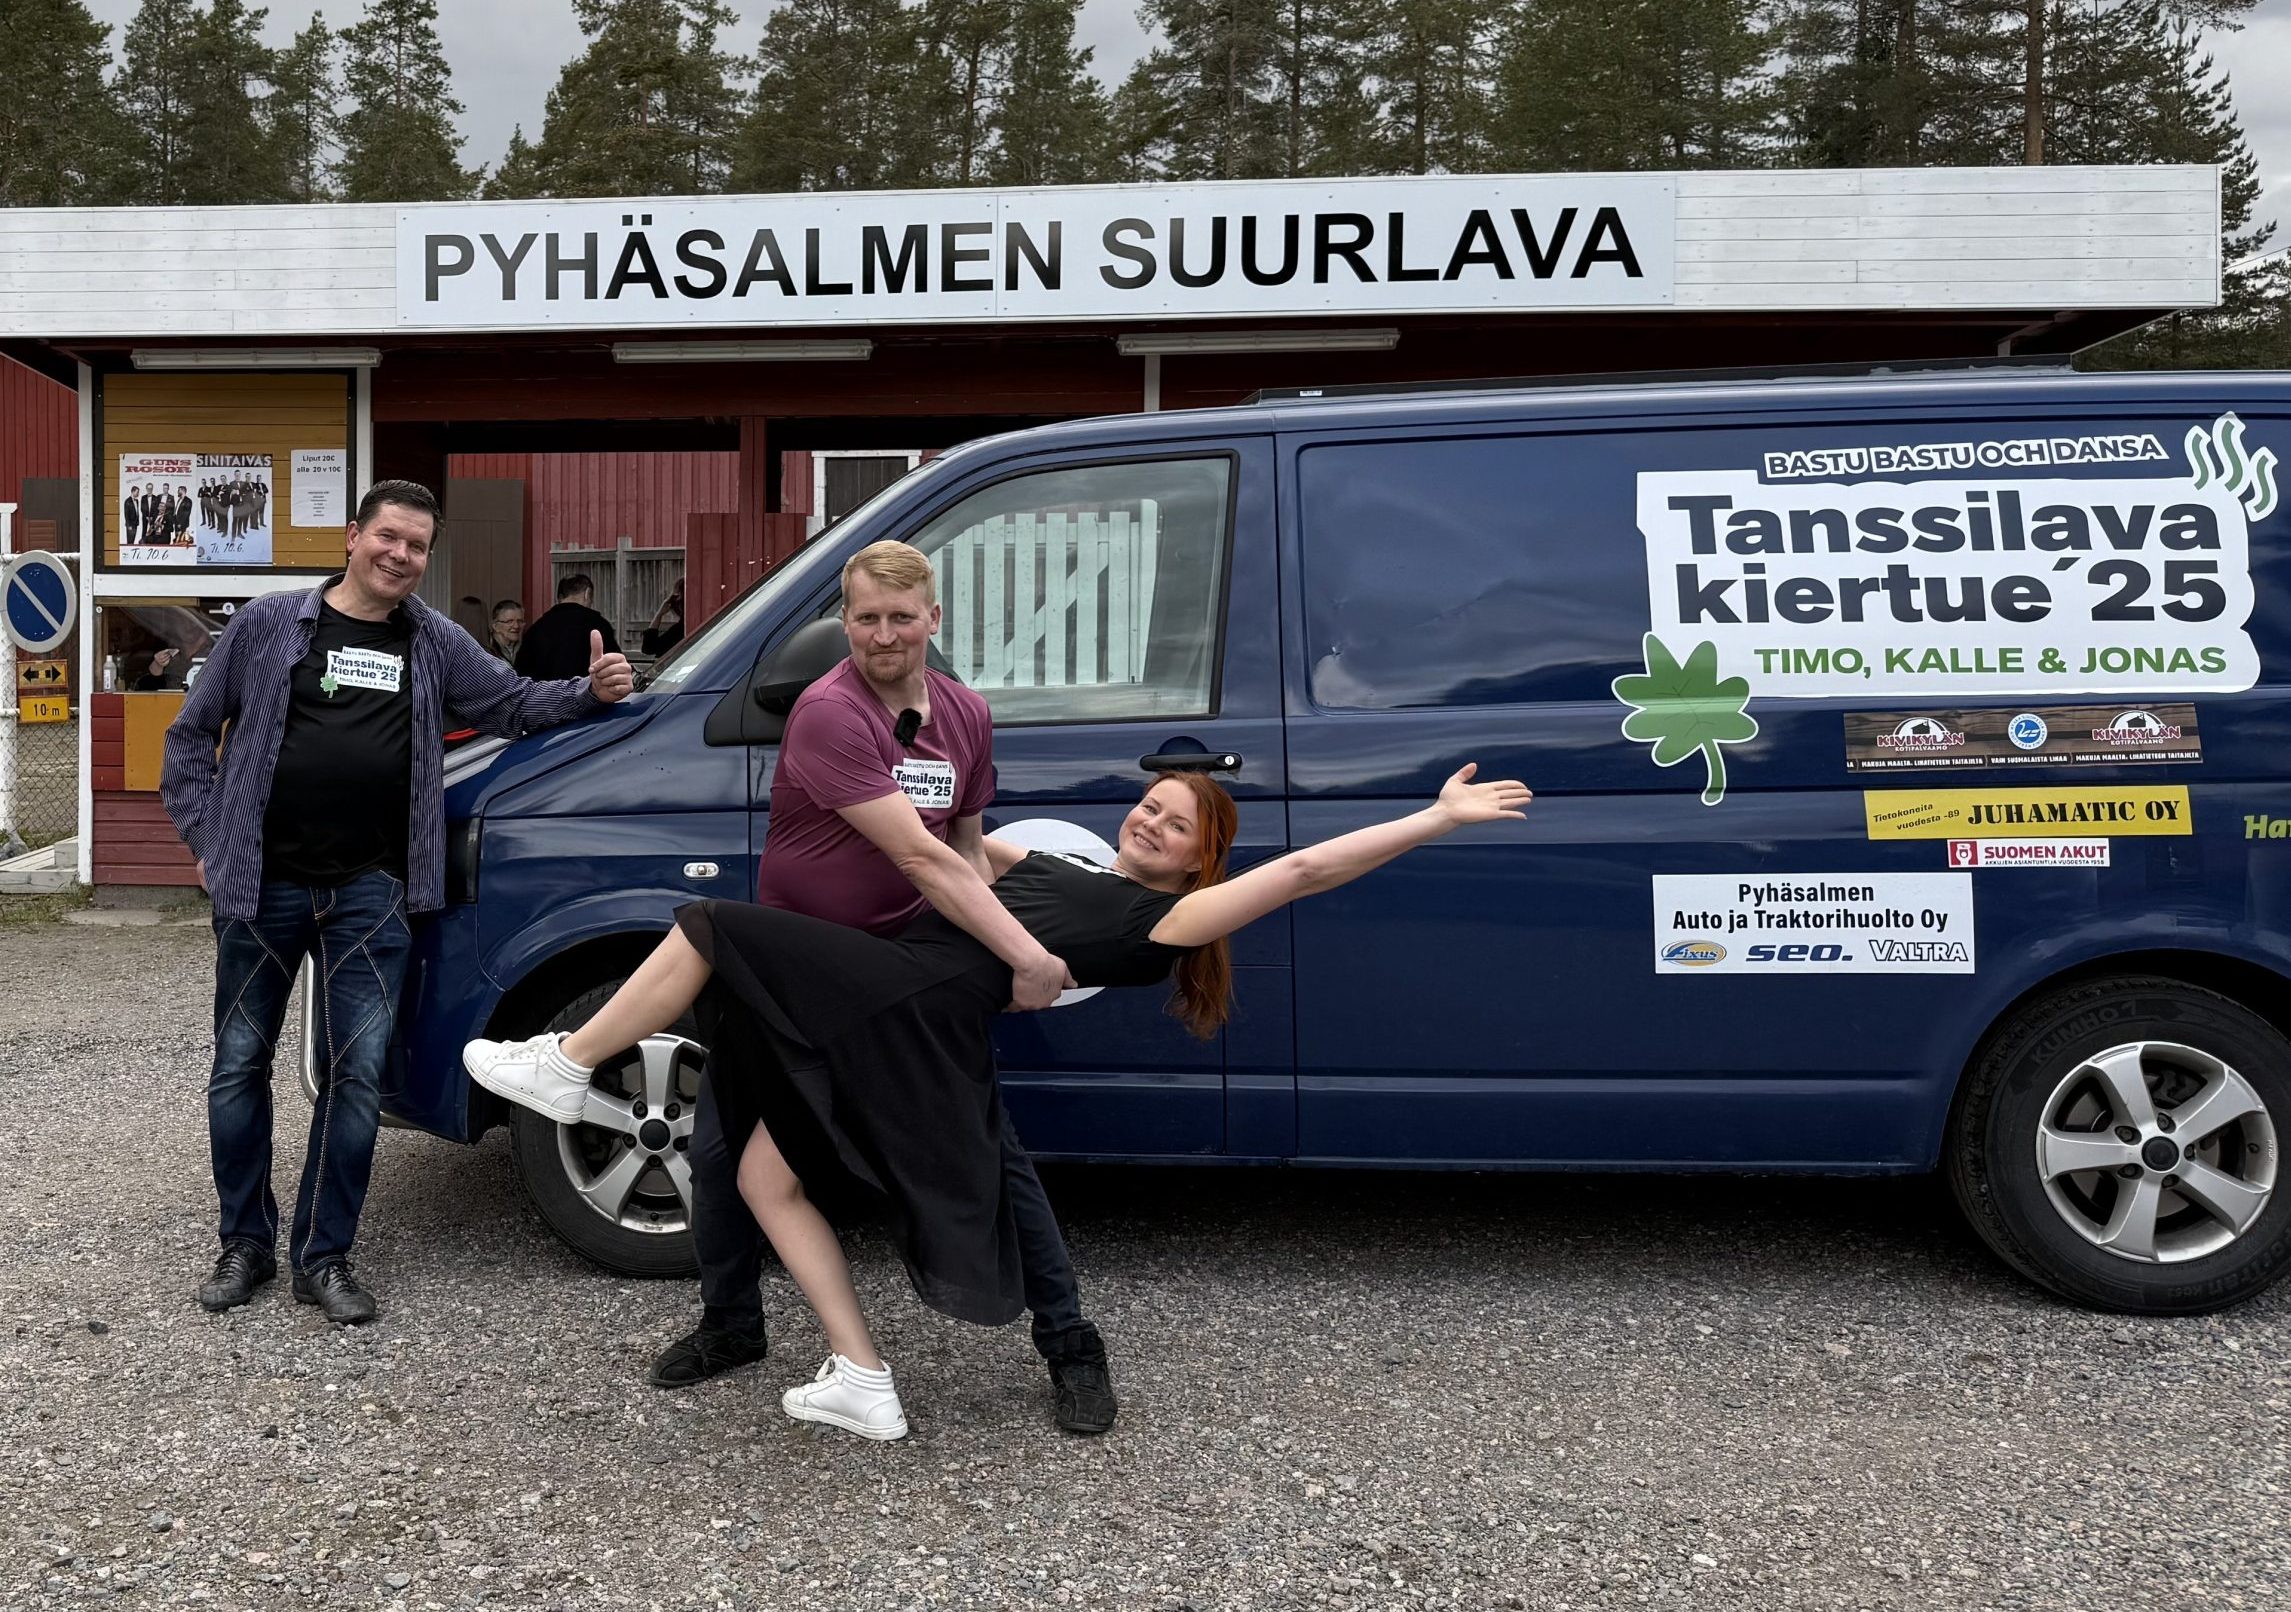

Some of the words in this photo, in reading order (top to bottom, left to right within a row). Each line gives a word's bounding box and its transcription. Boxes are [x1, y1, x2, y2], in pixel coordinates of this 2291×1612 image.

[424, 214, 1062, 302] PYHÄSALMEN
[1099, 206, 1644, 290] SUURLAVA
[138, 458, 192, 466] GUNS
[197, 455, 272, 467] SINITAIVAS
[1768, 452, 1866, 475] BASTU
[1873, 446, 1970, 469] BASTU
[1979, 442, 2046, 464] OCH
[2054, 438, 2163, 461] DANSA
[1667, 490, 2222, 555] Tanssilava
[330, 654, 397, 673] Tanssilava
[1753, 647, 1872, 680] TIMO,
[1884, 647, 2025, 674] KALLE
[2037, 646, 2067, 674] &
[2079, 646, 2227, 674] JONAS
[33, 703, 47, 717] 10
[51, 707, 60, 716] m
[1877, 731, 1965, 747] KIVIKYLÄN
[2092, 725, 2182, 741] KIVIKYLÄN
[895, 769, 952, 785] Tanssilava
[1872, 803, 1933, 823] Tietokoneita
[1896, 815, 1941, 830] vuodesta
[1943, 809, 1960, 819] -89
[1967, 801, 2136, 825] JUHAMATIC
[2145, 800, 2181, 821] OY
[1984, 845, 2056, 859] SUOMEN
[2060, 845, 2107, 859] AKUT
[1737, 882, 1875, 907] Pyhäsalmen
[1672, 909, 1723, 930] Auto
[1727, 909, 1748, 934] ja
[1754, 908, 1915, 930] Traktorihuolto
[1920, 908, 1949, 933] Oy
[1662, 942, 1719, 960] Fixus
[1867, 938, 1969, 963] VALTRA
[2030, 1007, 2120, 1065] KUMHO
